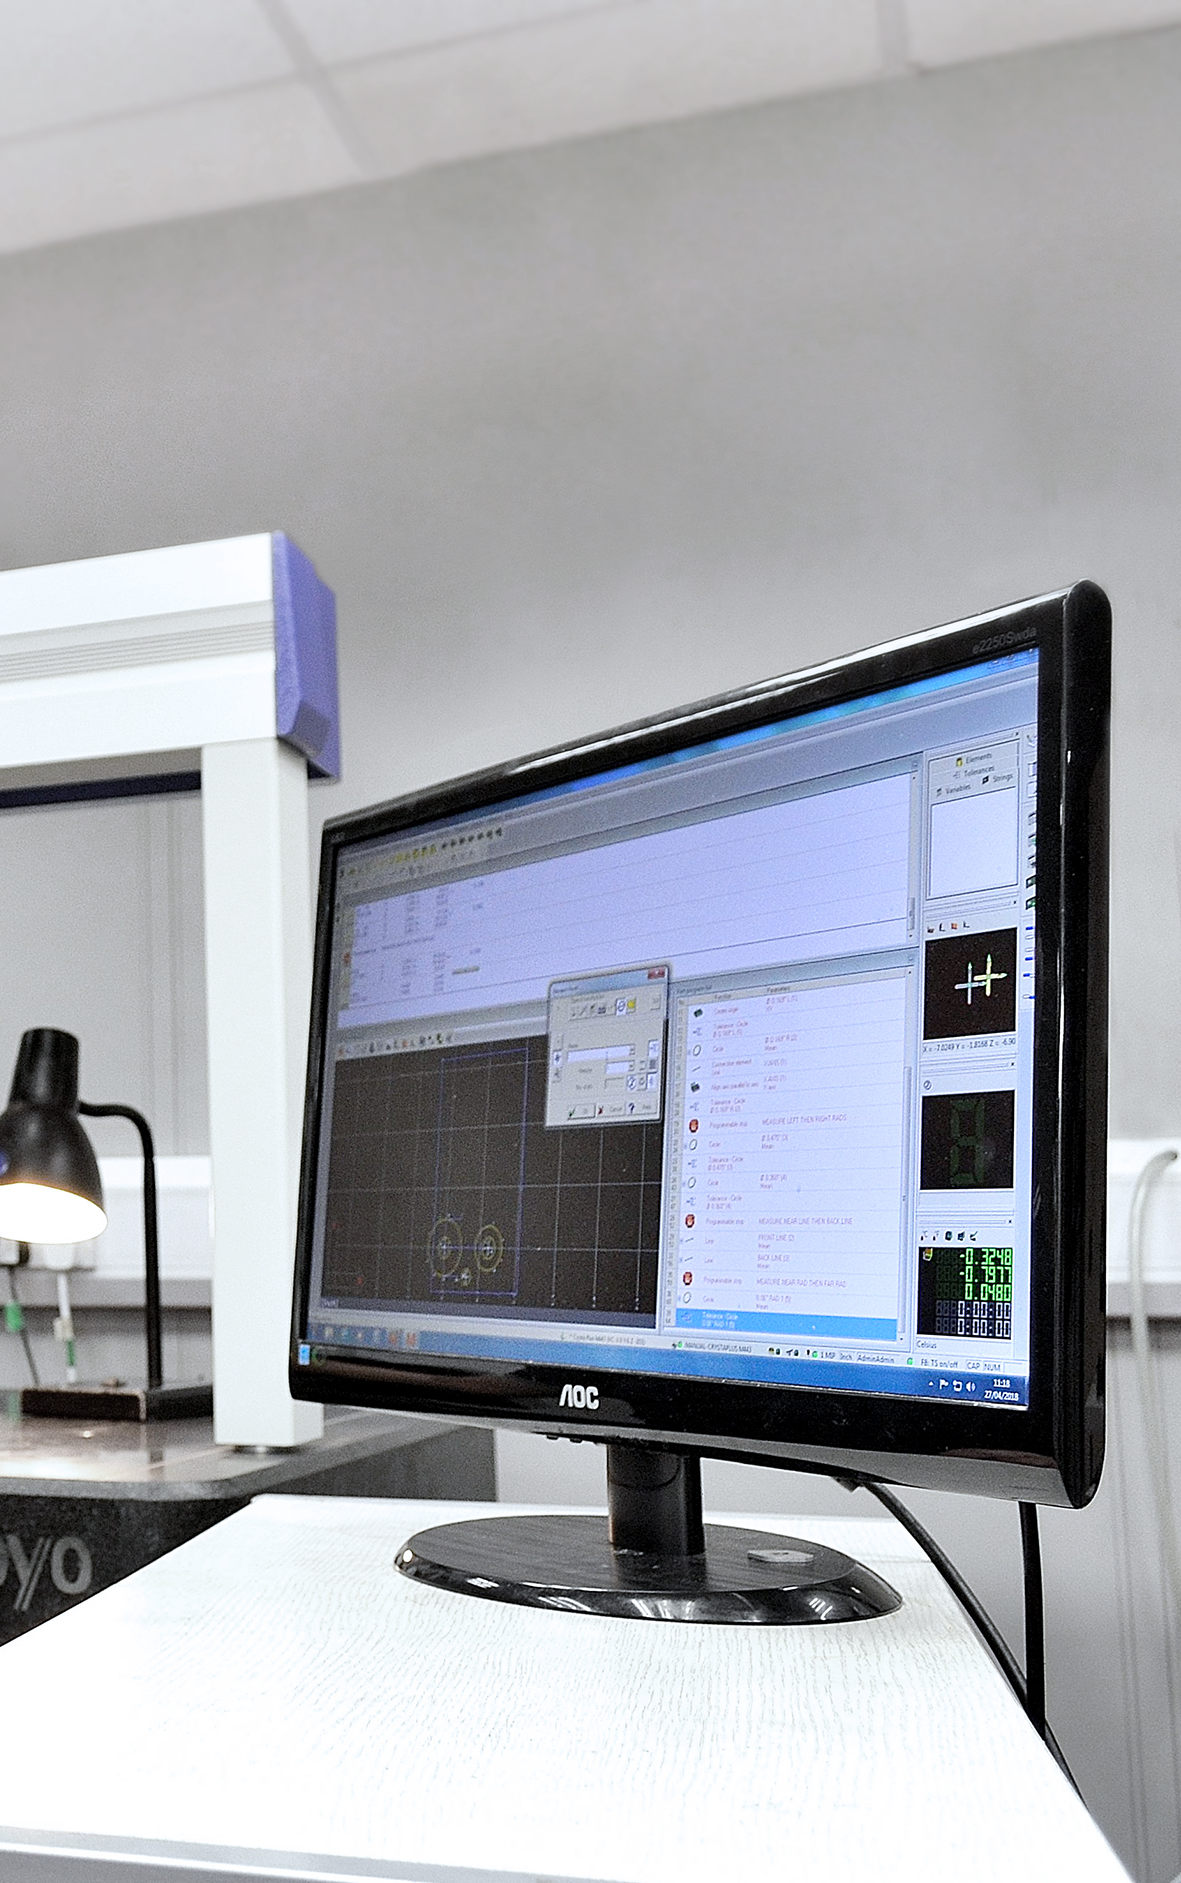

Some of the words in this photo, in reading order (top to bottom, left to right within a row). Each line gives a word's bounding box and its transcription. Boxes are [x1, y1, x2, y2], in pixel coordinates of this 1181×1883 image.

[965, 752, 993, 764] Elements
[963, 765, 995, 778] Tolerances
[992, 773, 1014, 784] Strings
[945, 783, 971, 796] Variables
[959, 1248, 1012, 1266] -0.3248
[959, 1265, 1012, 1283] -0.7977
[965, 1283, 1012, 1301] 0.0480
[917, 1340, 937, 1349] Celsius
[939, 1359, 958, 1369] on/off
[967, 1361, 980, 1370] CAP
[984, 1362, 1001, 1371] NUM
[993, 1379, 1011, 1388] 11:18
[559, 1384, 600, 1410] AOC
[984, 1390, 1019, 1402] 27/04/2018
